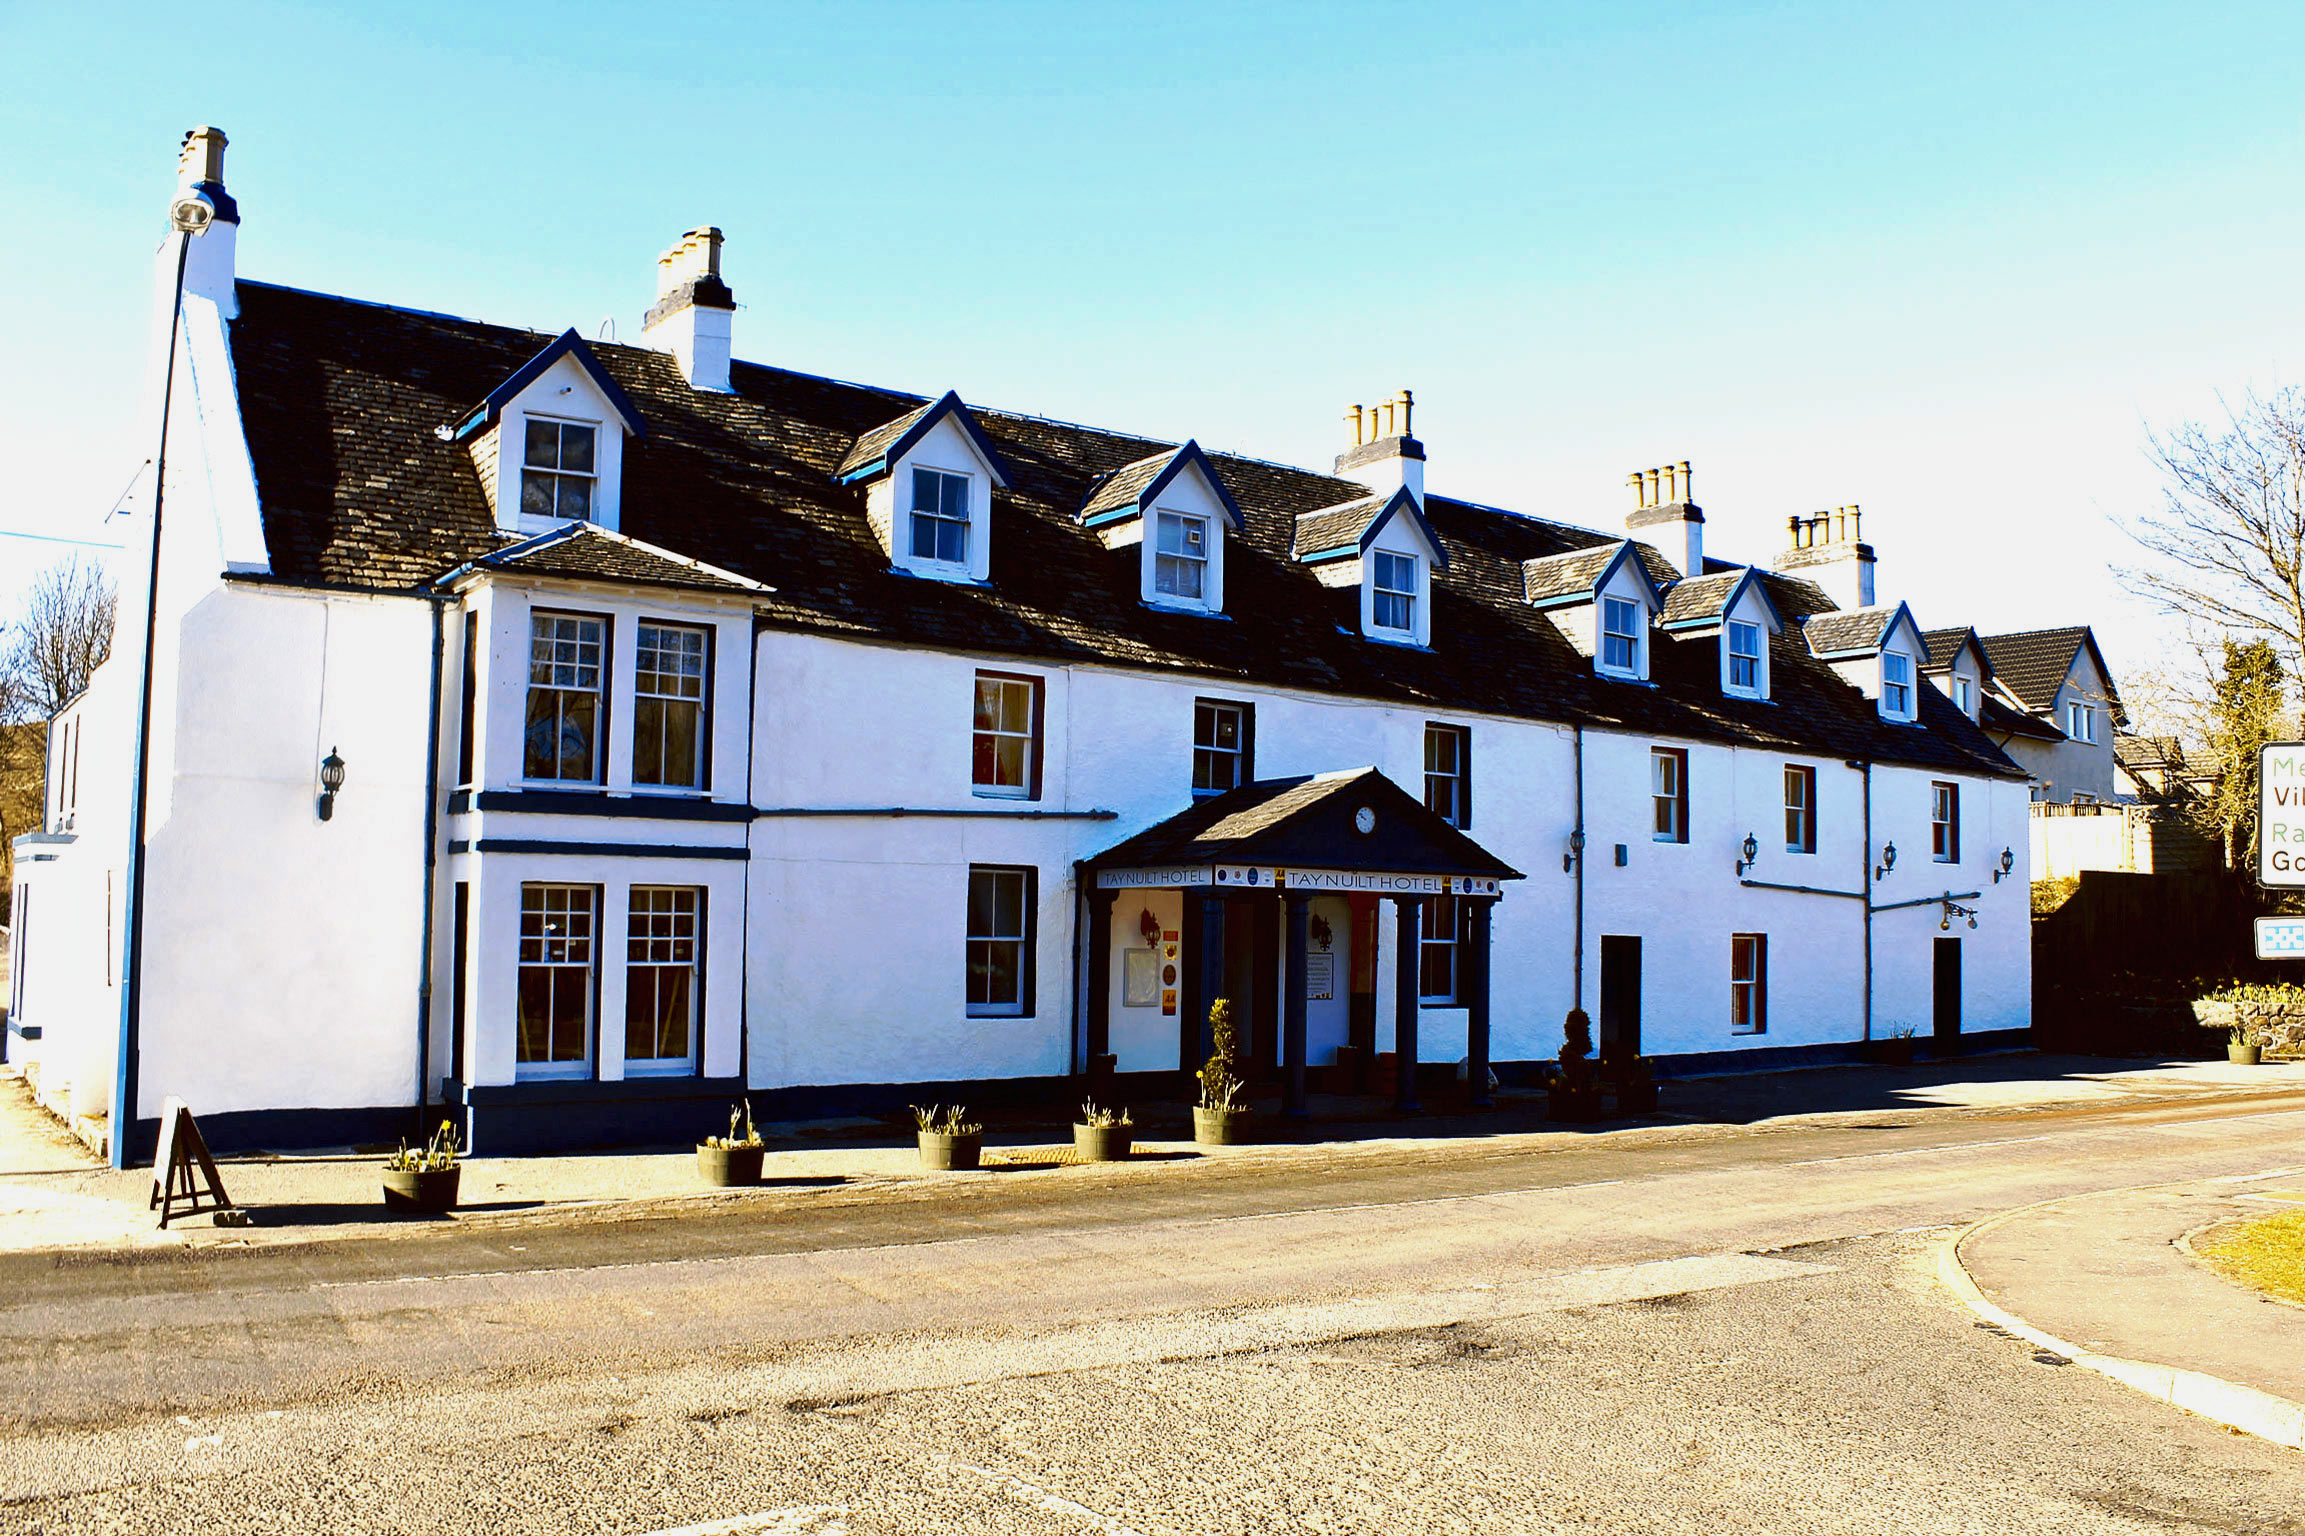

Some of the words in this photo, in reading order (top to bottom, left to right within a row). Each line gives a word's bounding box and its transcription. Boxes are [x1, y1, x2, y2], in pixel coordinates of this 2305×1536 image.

[2272, 823, 2305, 843] Ra
[1106, 871, 1157, 885] TAYNUILT
[1161, 869, 1205, 884] HOTEL
[1288, 872, 1375, 888] TAYNUILT
[1380, 874, 1442, 891] HOTEL
